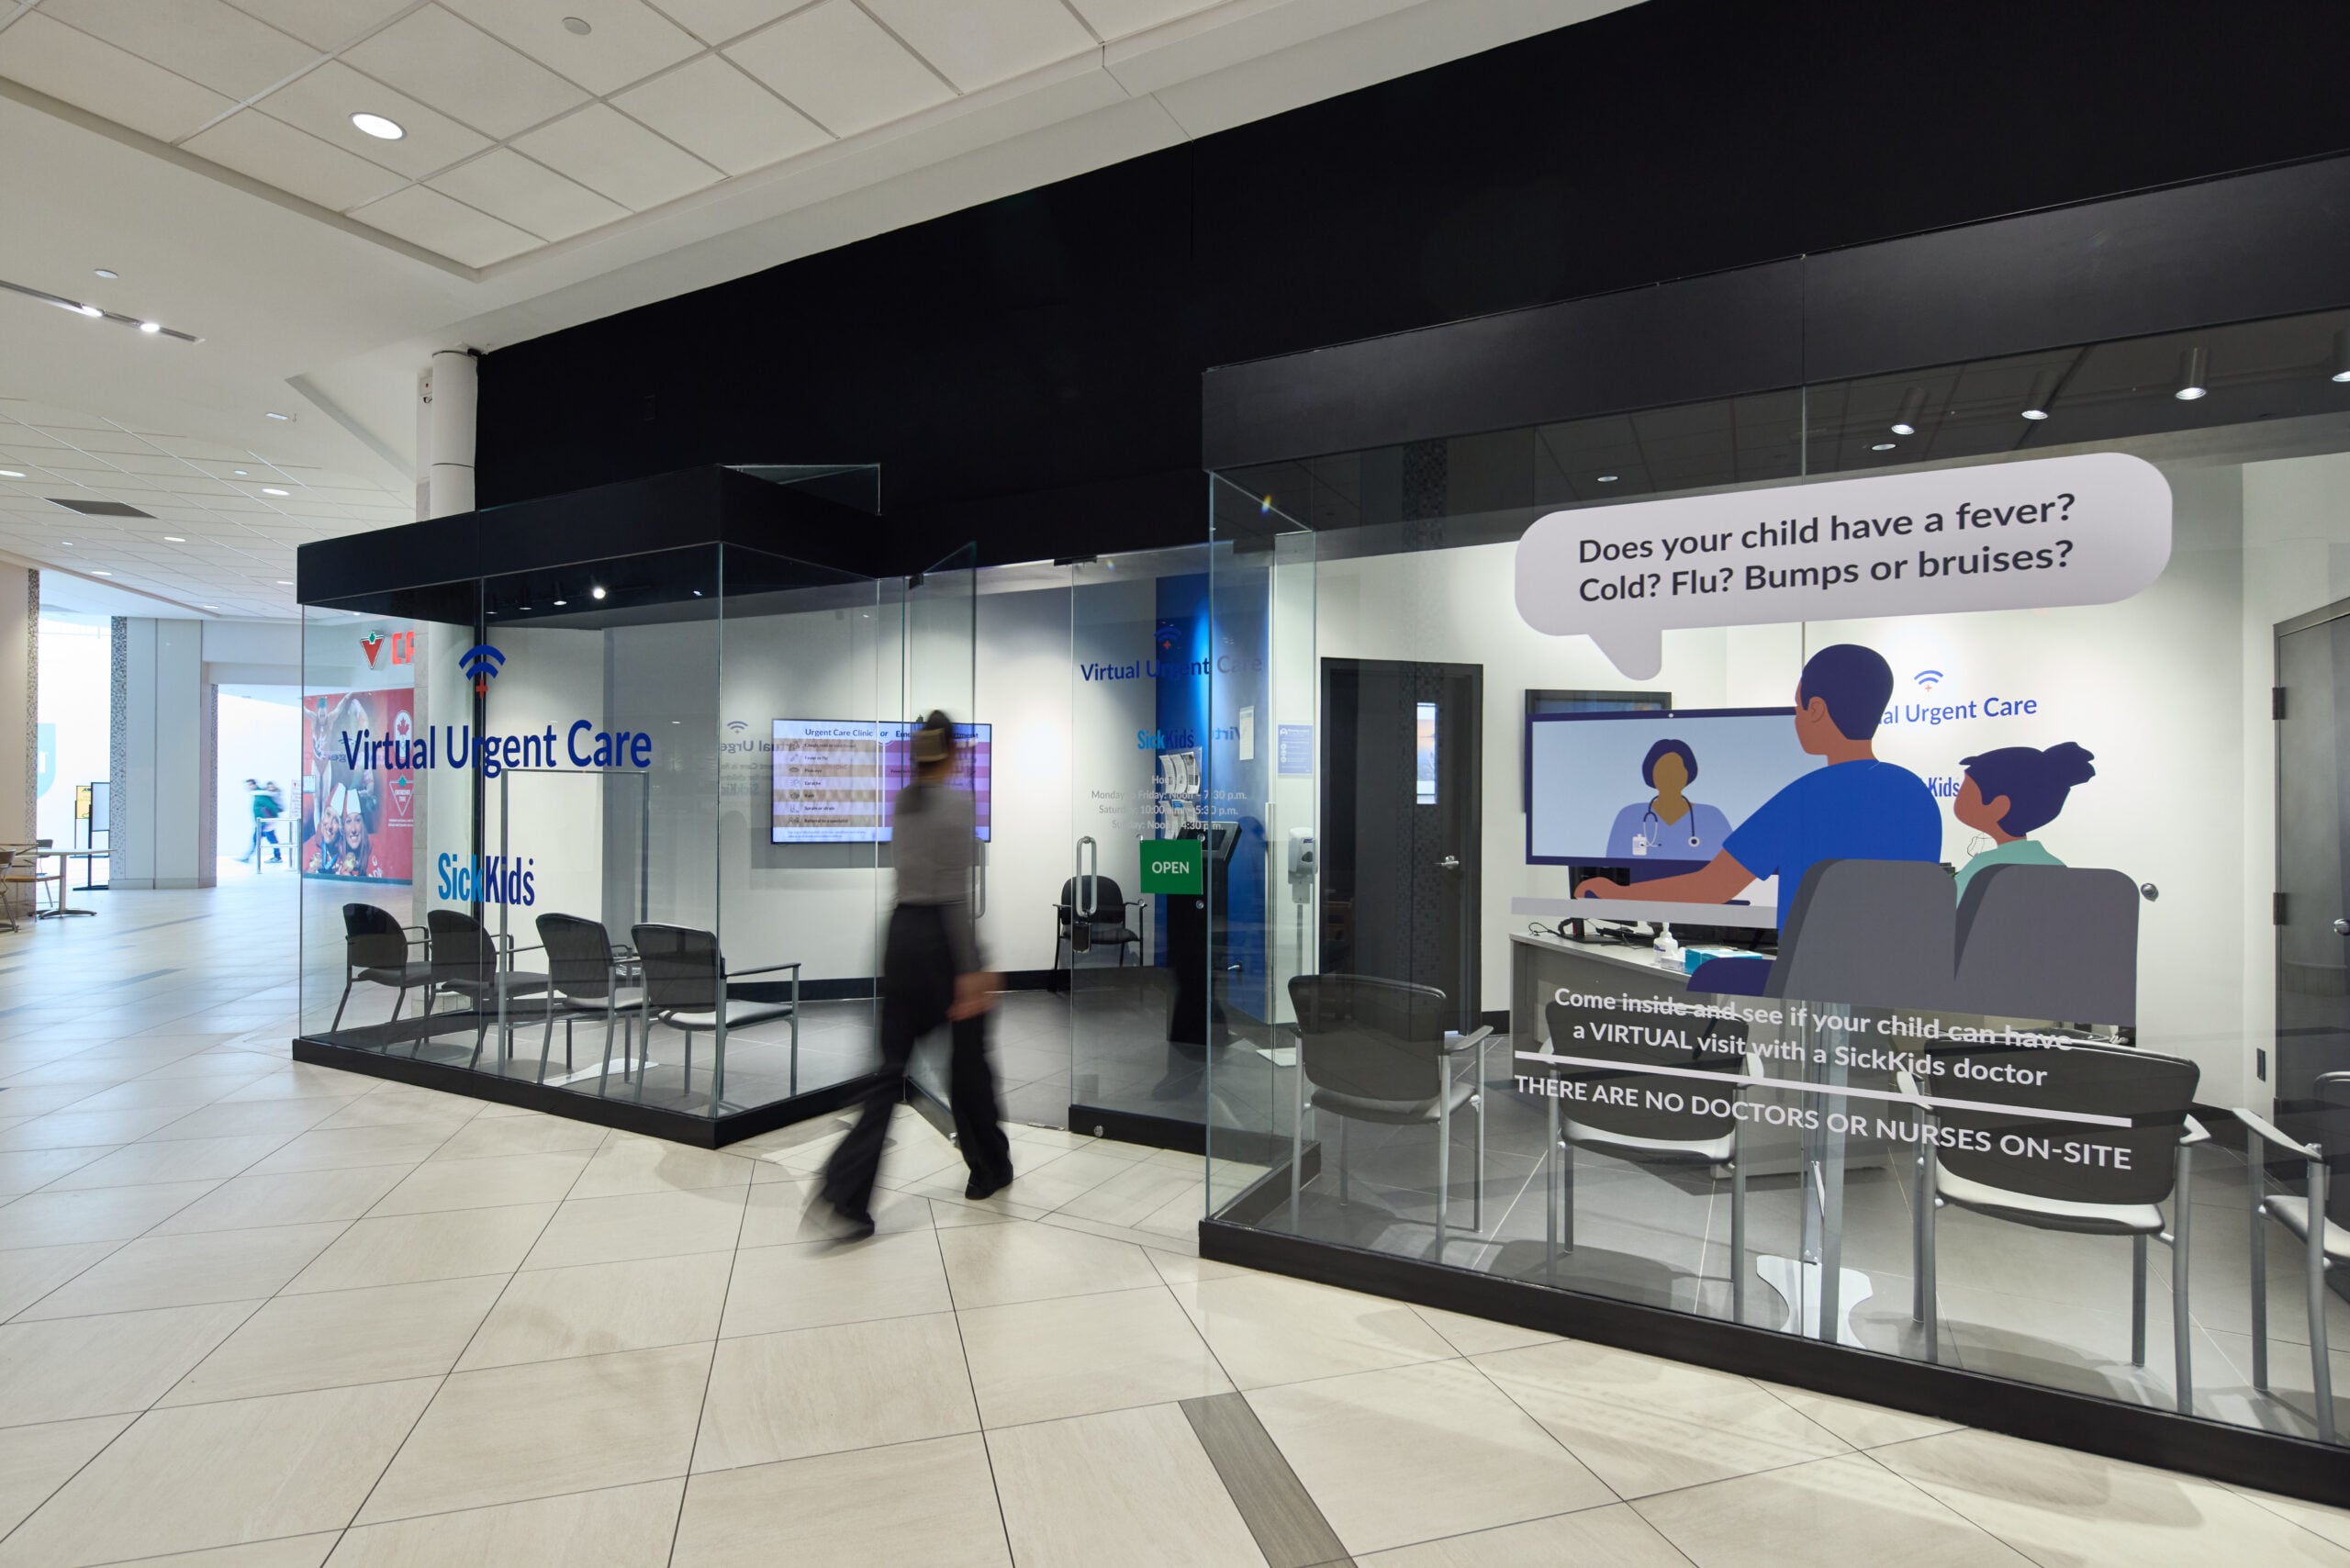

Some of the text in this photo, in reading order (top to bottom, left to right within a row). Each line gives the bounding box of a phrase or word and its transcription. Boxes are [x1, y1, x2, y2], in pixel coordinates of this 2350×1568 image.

[1579, 492, 2076, 564] Does your child have a fever?
[1578, 538, 2075, 602] Cold? Flu? Bumps or bruises?
[1080, 655, 1263, 681] Virtual Urgent Care
[1906, 700, 1977, 725] Urgent
[1983, 697, 2038, 717] Care
[805, 728, 831, 738] Urgent
[833, 728, 851, 736] Care
[853, 729, 874, 737] Clinic
[1137, 729, 1194, 749] SickKids
[341, 719, 653, 779] Virtual Urgent Care
[1091, 790, 1125, 801] Monday
[1137, 790, 1167, 801] Friday:
[1169, 791, 1193, 801] Noon
[1227, 791, 1248, 801] p.m.
[1141, 805, 1165, 815] 10:00
[1219, 806, 1239, 817] p.m.
[1181, 820, 1202, 830] 4:30
[438, 852, 535, 907] SickKids
[1151, 861, 1190, 874] OPEN
[1555, 988, 2074, 1051] Come inside and see if your child can have
[1572, 1022, 2049, 1086] a VIRTUAL visit with a SickKids doctor
[1515, 1074, 2132, 1171] THERE ARE NO DOCTORS OR NURSES ON-SITE
